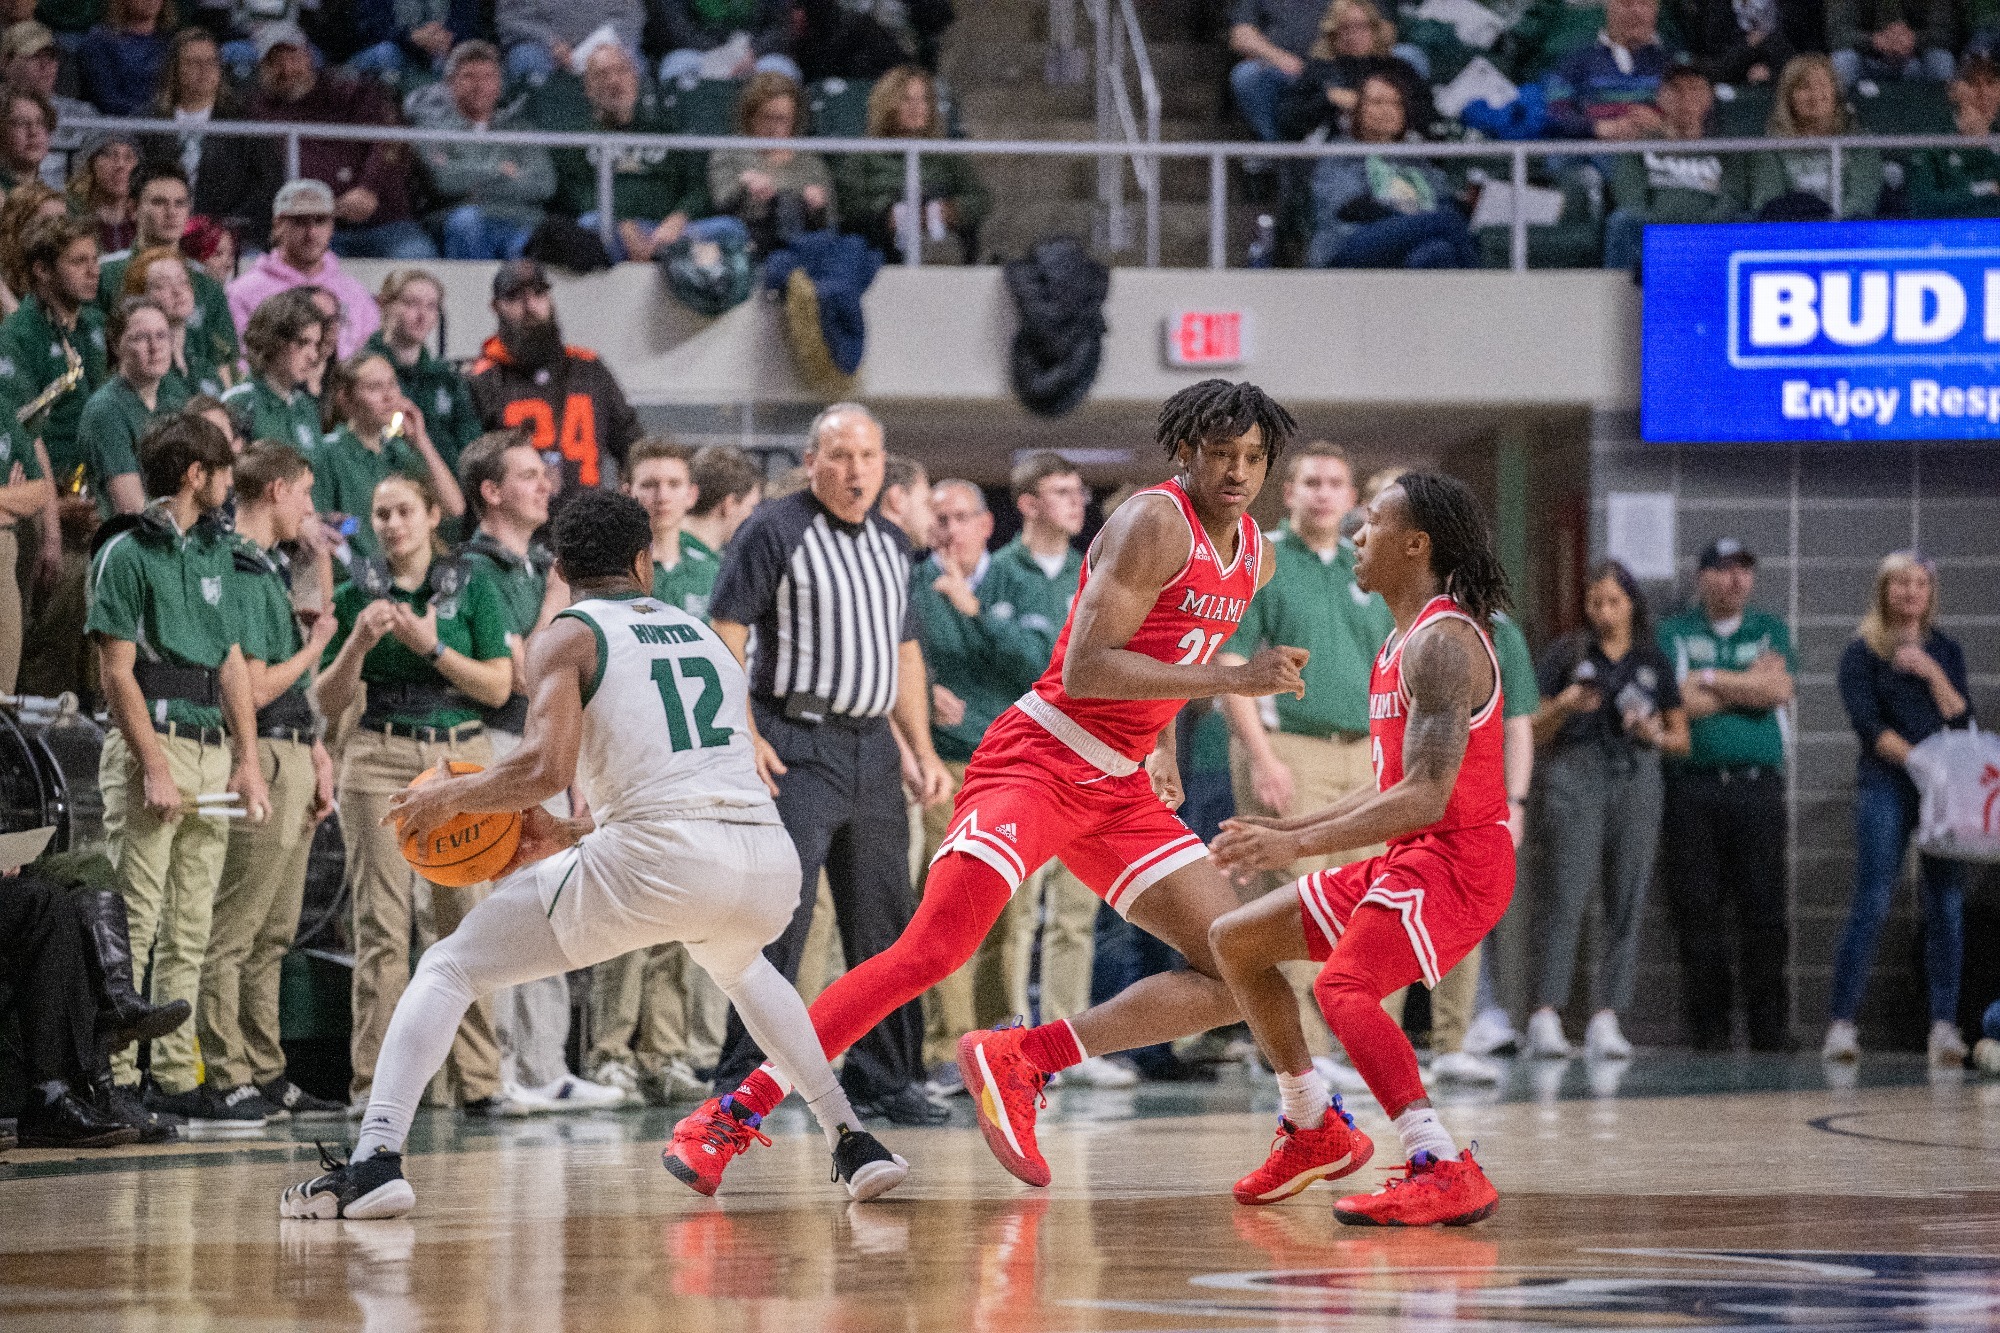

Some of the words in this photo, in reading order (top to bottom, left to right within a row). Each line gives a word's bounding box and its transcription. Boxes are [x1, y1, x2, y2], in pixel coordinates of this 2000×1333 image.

[1750, 269, 1967, 348] BUD
[1181, 311, 1241, 362] EXIT
[1781, 377, 1900, 427] Enjoy
[503, 393, 600, 486] 24
[1177, 587, 1246, 622] MIAMI
[1174, 627, 1225, 665] 21
[650, 656, 735, 753] 12
